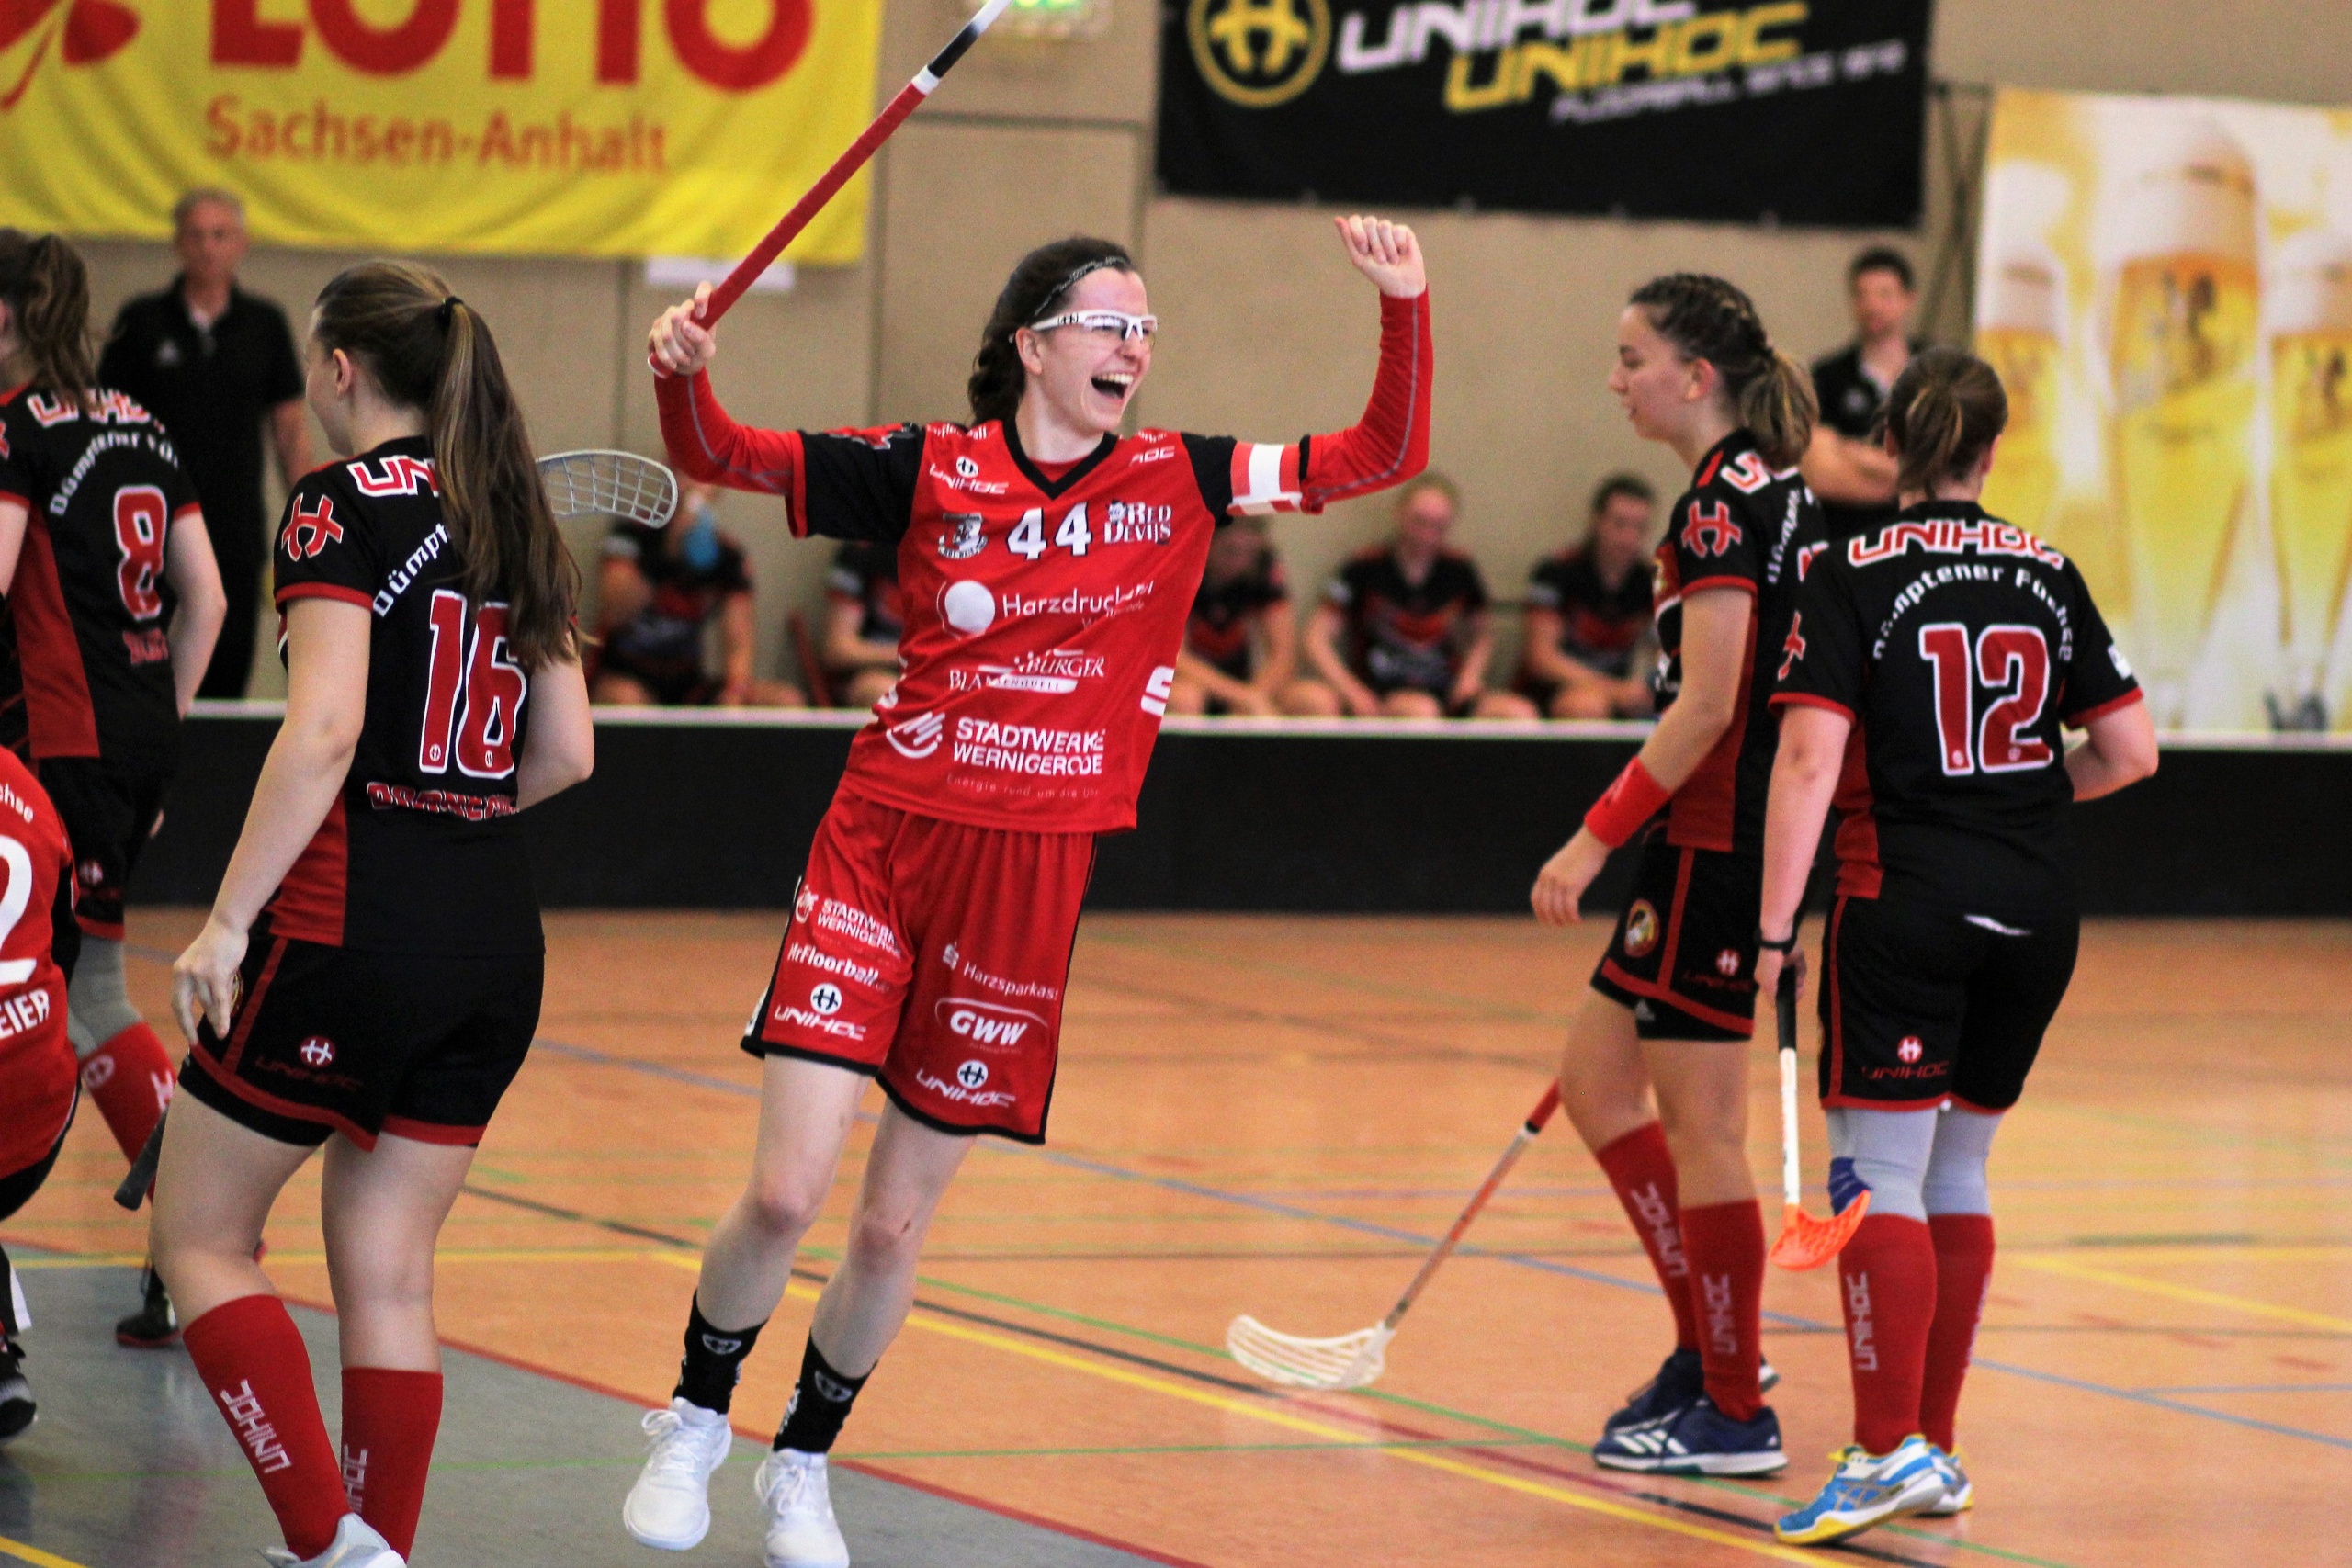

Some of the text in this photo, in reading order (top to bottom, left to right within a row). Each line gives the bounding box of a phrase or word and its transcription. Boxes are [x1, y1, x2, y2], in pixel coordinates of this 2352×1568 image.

[1444, 3, 1807, 111] UNIHOC
[205, 95, 669, 175] Sachsen-Anhalt
[929, 463, 1010, 495] UNIHOC
[113, 484, 167, 621] 8
[1007, 502, 1091, 561] 44
[1848, 519, 2065, 570] UNIHOC
[419, 589, 526, 780] 16
[1919, 623, 2054, 776] 12
[953, 740, 1104, 777] WERNIGERODE
[956, 716, 1105, 755] STADTWERKE
[0, 989, 50, 1040] EIER
[775, 1006, 867, 1041] UNIHOC
[950, 1010, 1028, 1046] GWW
[916, 1068, 1015, 1108] UNIHOC
